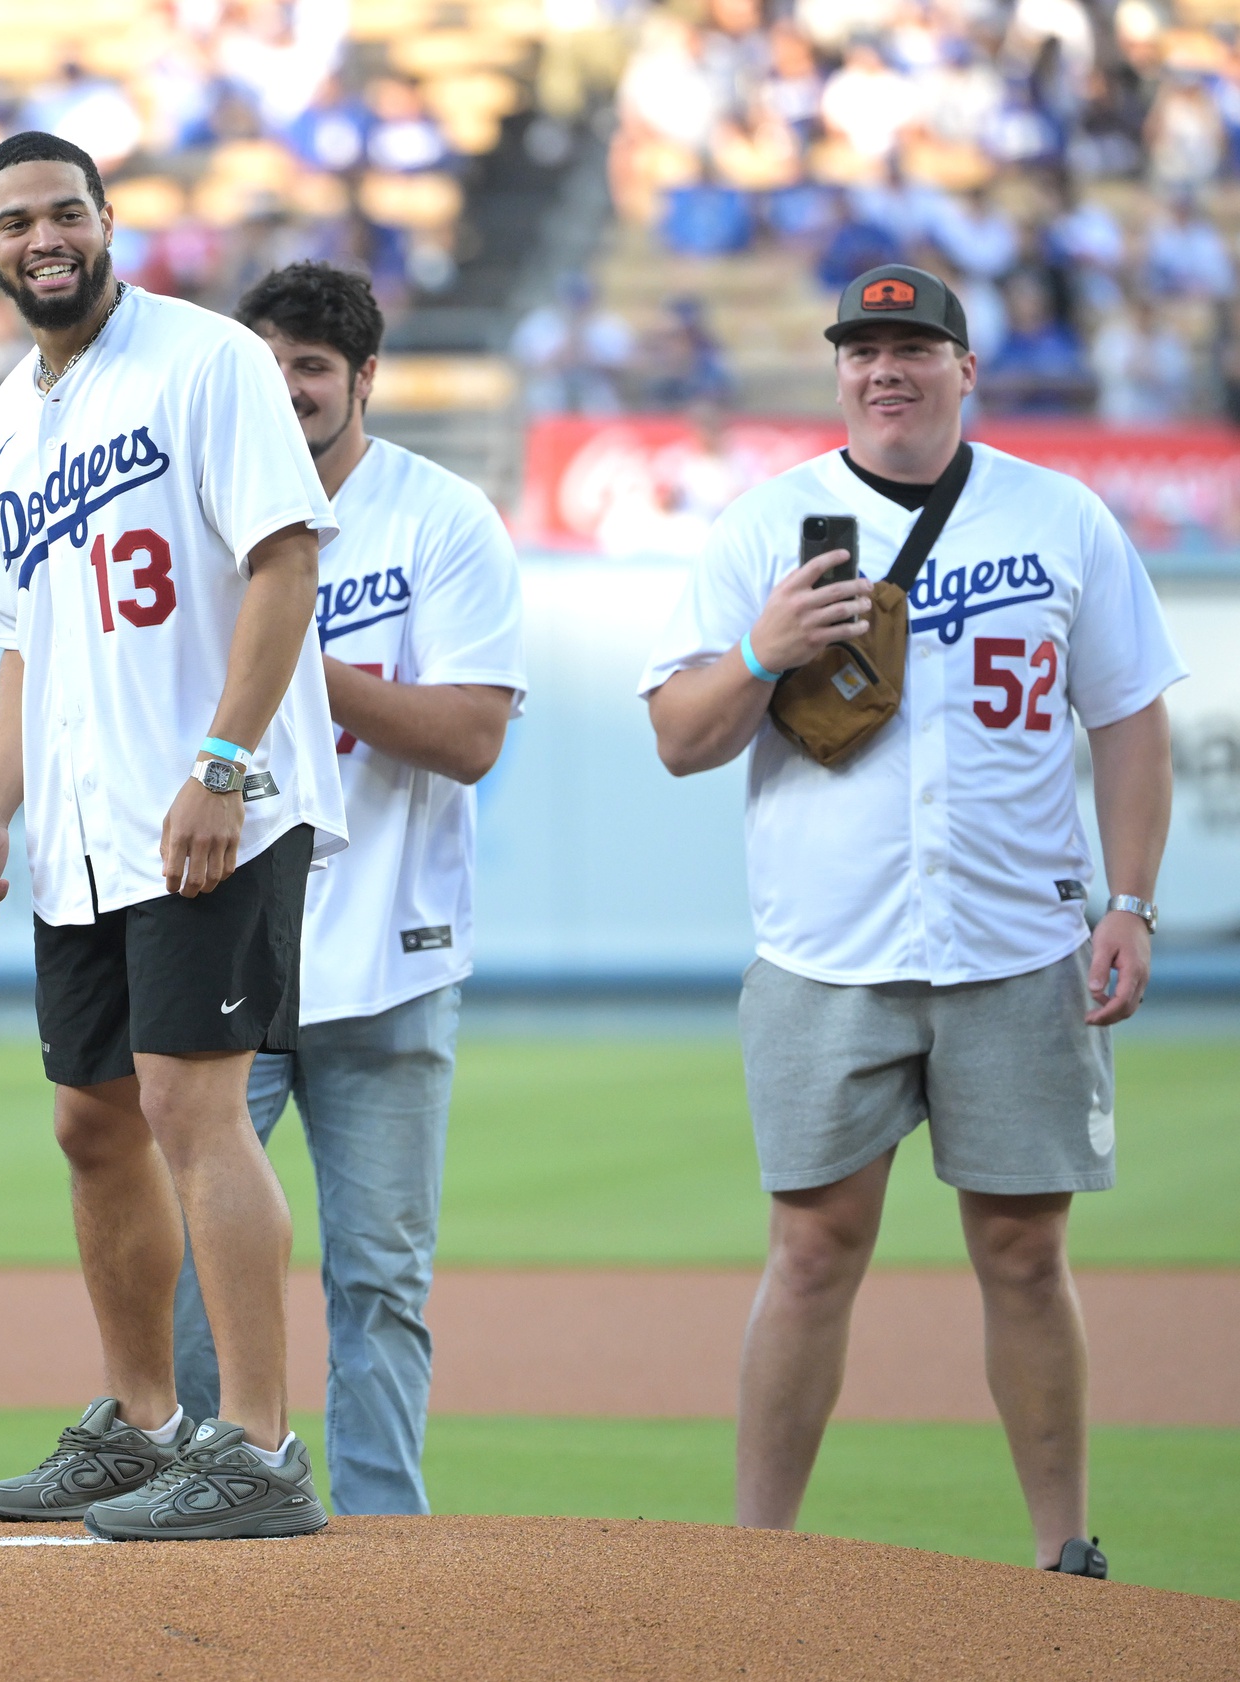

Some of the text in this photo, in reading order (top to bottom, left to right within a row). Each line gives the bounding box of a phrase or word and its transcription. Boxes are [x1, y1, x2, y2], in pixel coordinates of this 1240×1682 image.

[90, 528, 177, 633] 13
[316, 566, 411, 653] gers
[907, 553, 1054, 645] dgers
[973, 637, 1058, 732] 52
